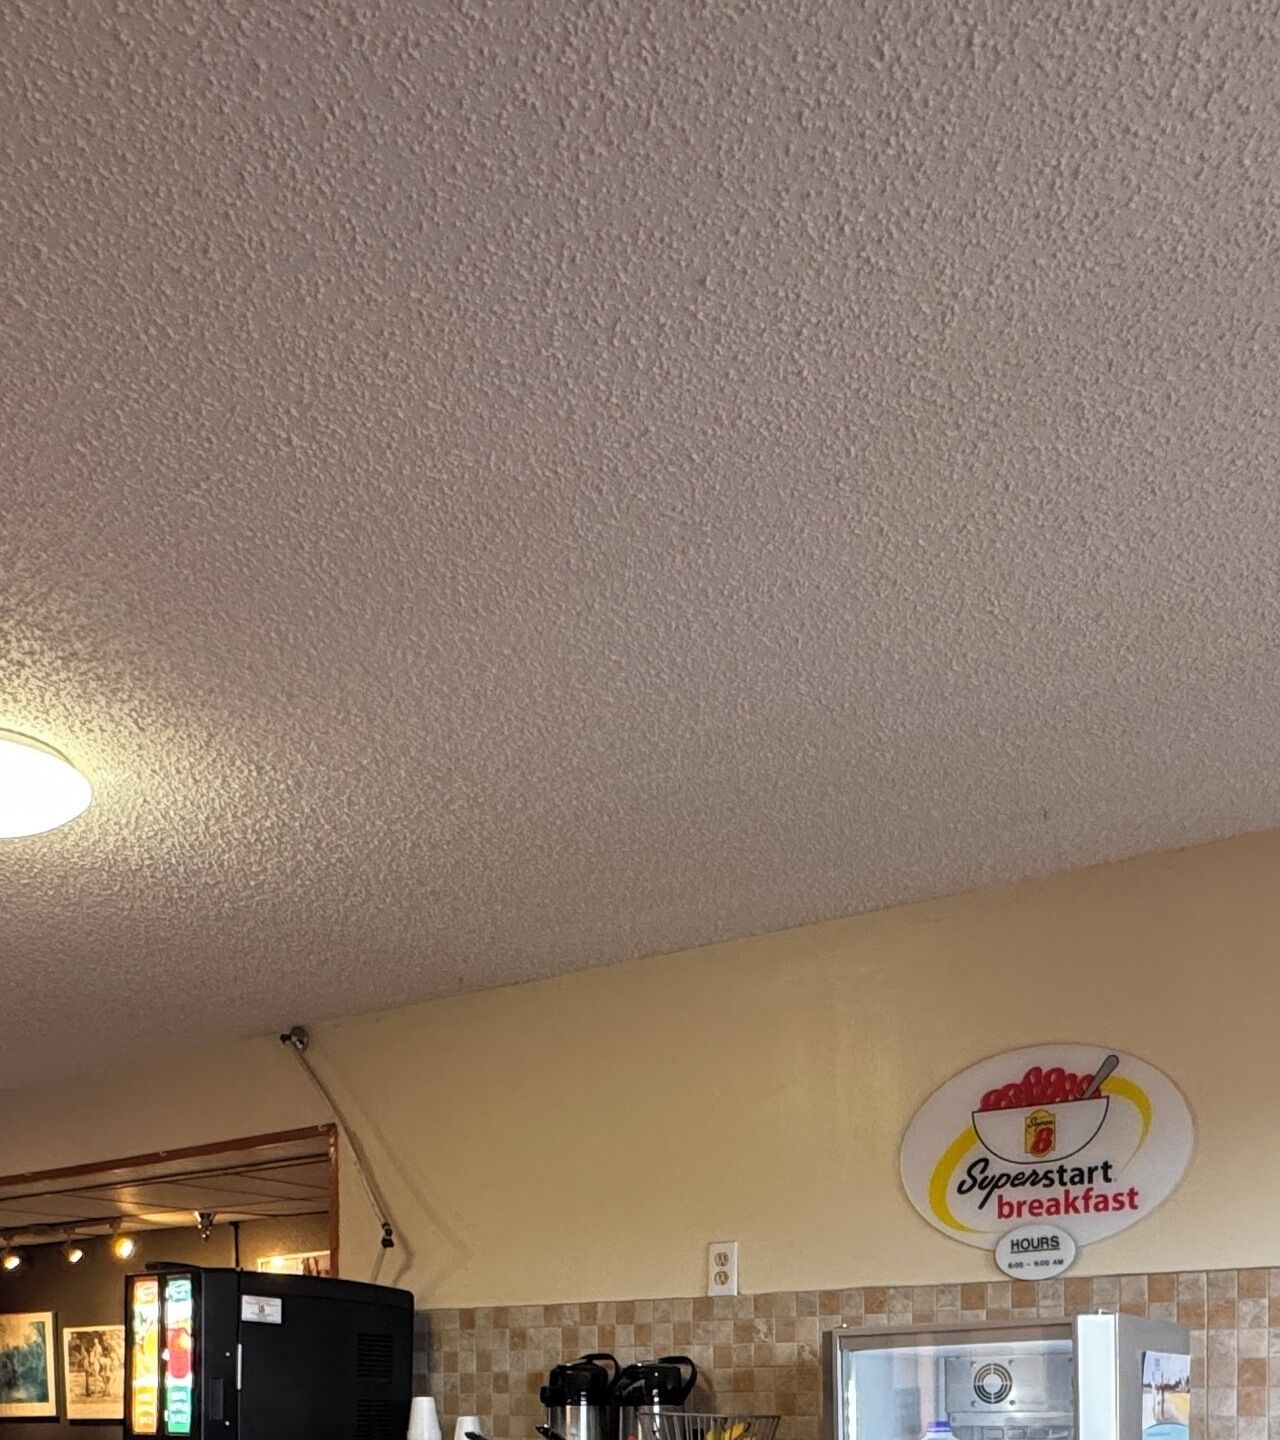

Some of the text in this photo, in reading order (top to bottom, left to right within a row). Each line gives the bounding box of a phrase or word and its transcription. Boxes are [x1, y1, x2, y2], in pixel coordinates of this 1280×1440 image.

[957, 1158, 1113, 1210] Superstart
[997, 1187, 1139, 1219] breakfast
[1010, 1235, 1060, 1251] HOURS
